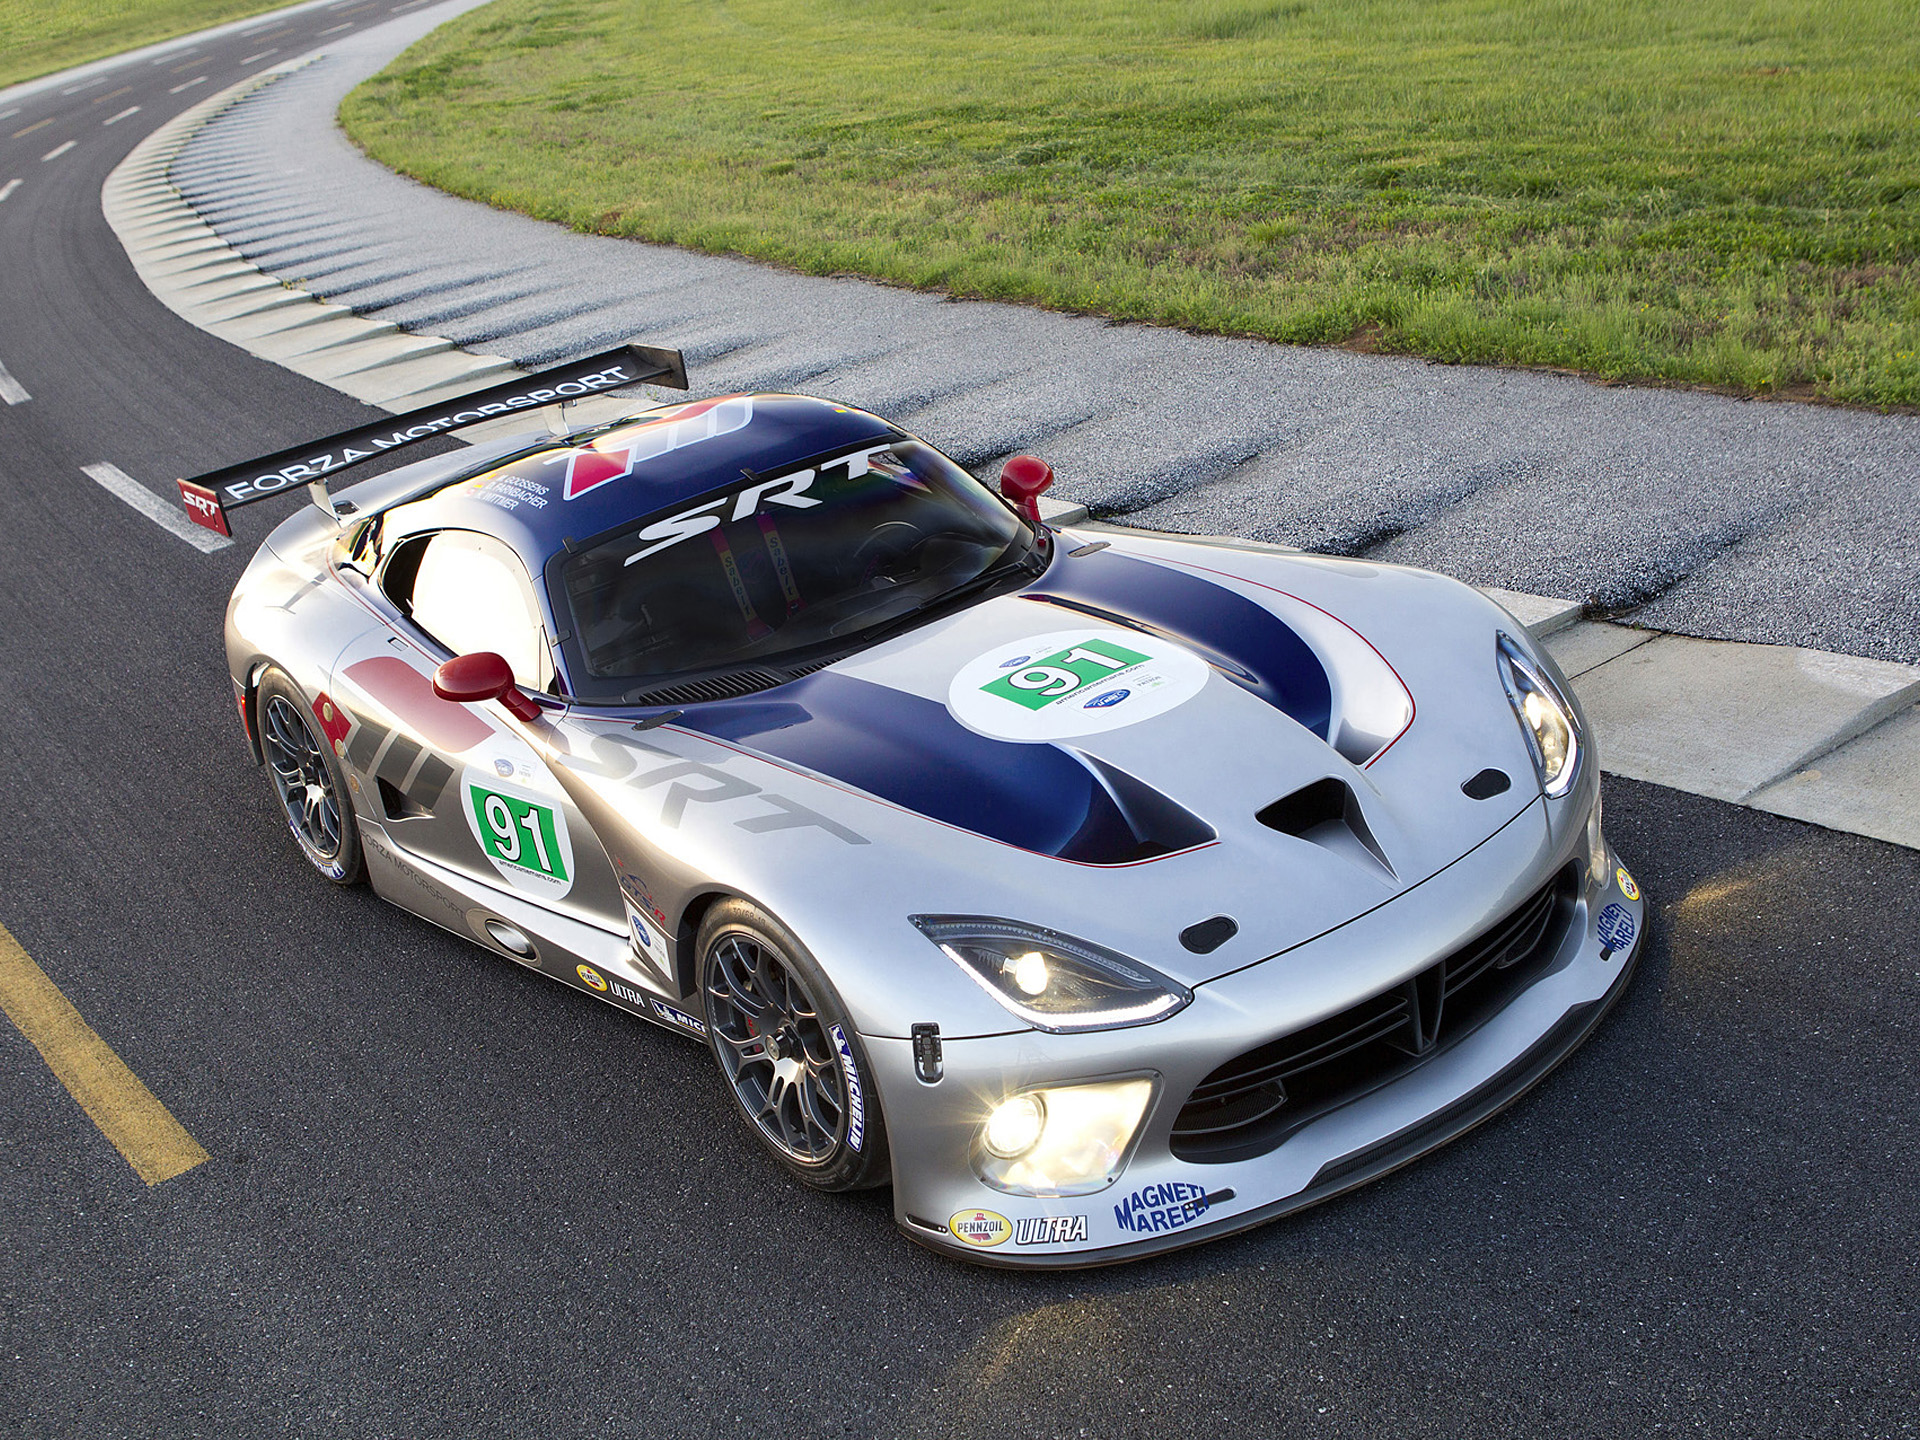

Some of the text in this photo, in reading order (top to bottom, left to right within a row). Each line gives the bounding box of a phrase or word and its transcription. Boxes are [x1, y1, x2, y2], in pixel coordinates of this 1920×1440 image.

[224, 366, 631, 500] FORZA MOTORSPORT
[183, 490, 219, 517] SRT
[624, 443, 891, 567] SRT
[724, 556, 751, 616] Sabelt
[769, 536, 793, 596] Sabelt
[1008, 647, 1129, 696] 91
[554, 733, 872, 845] SRT
[484, 794, 554, 874] 91
[360, 829, 393, 862] FORZA
[394, 857, 465, 920] MOTORSPORT
[609, 980, 646, 1009] ULTRA
[841, 1053, 863, 1150] MICHELIN
[957, 1220, 1004, 1234] PENNZOIL
[1015, 1215, 1089, 1246] ULTRA
[1114, 1182, 1210, 1224] MAGNETI
[1114, 1196, 1210, 1233] MARELLI
